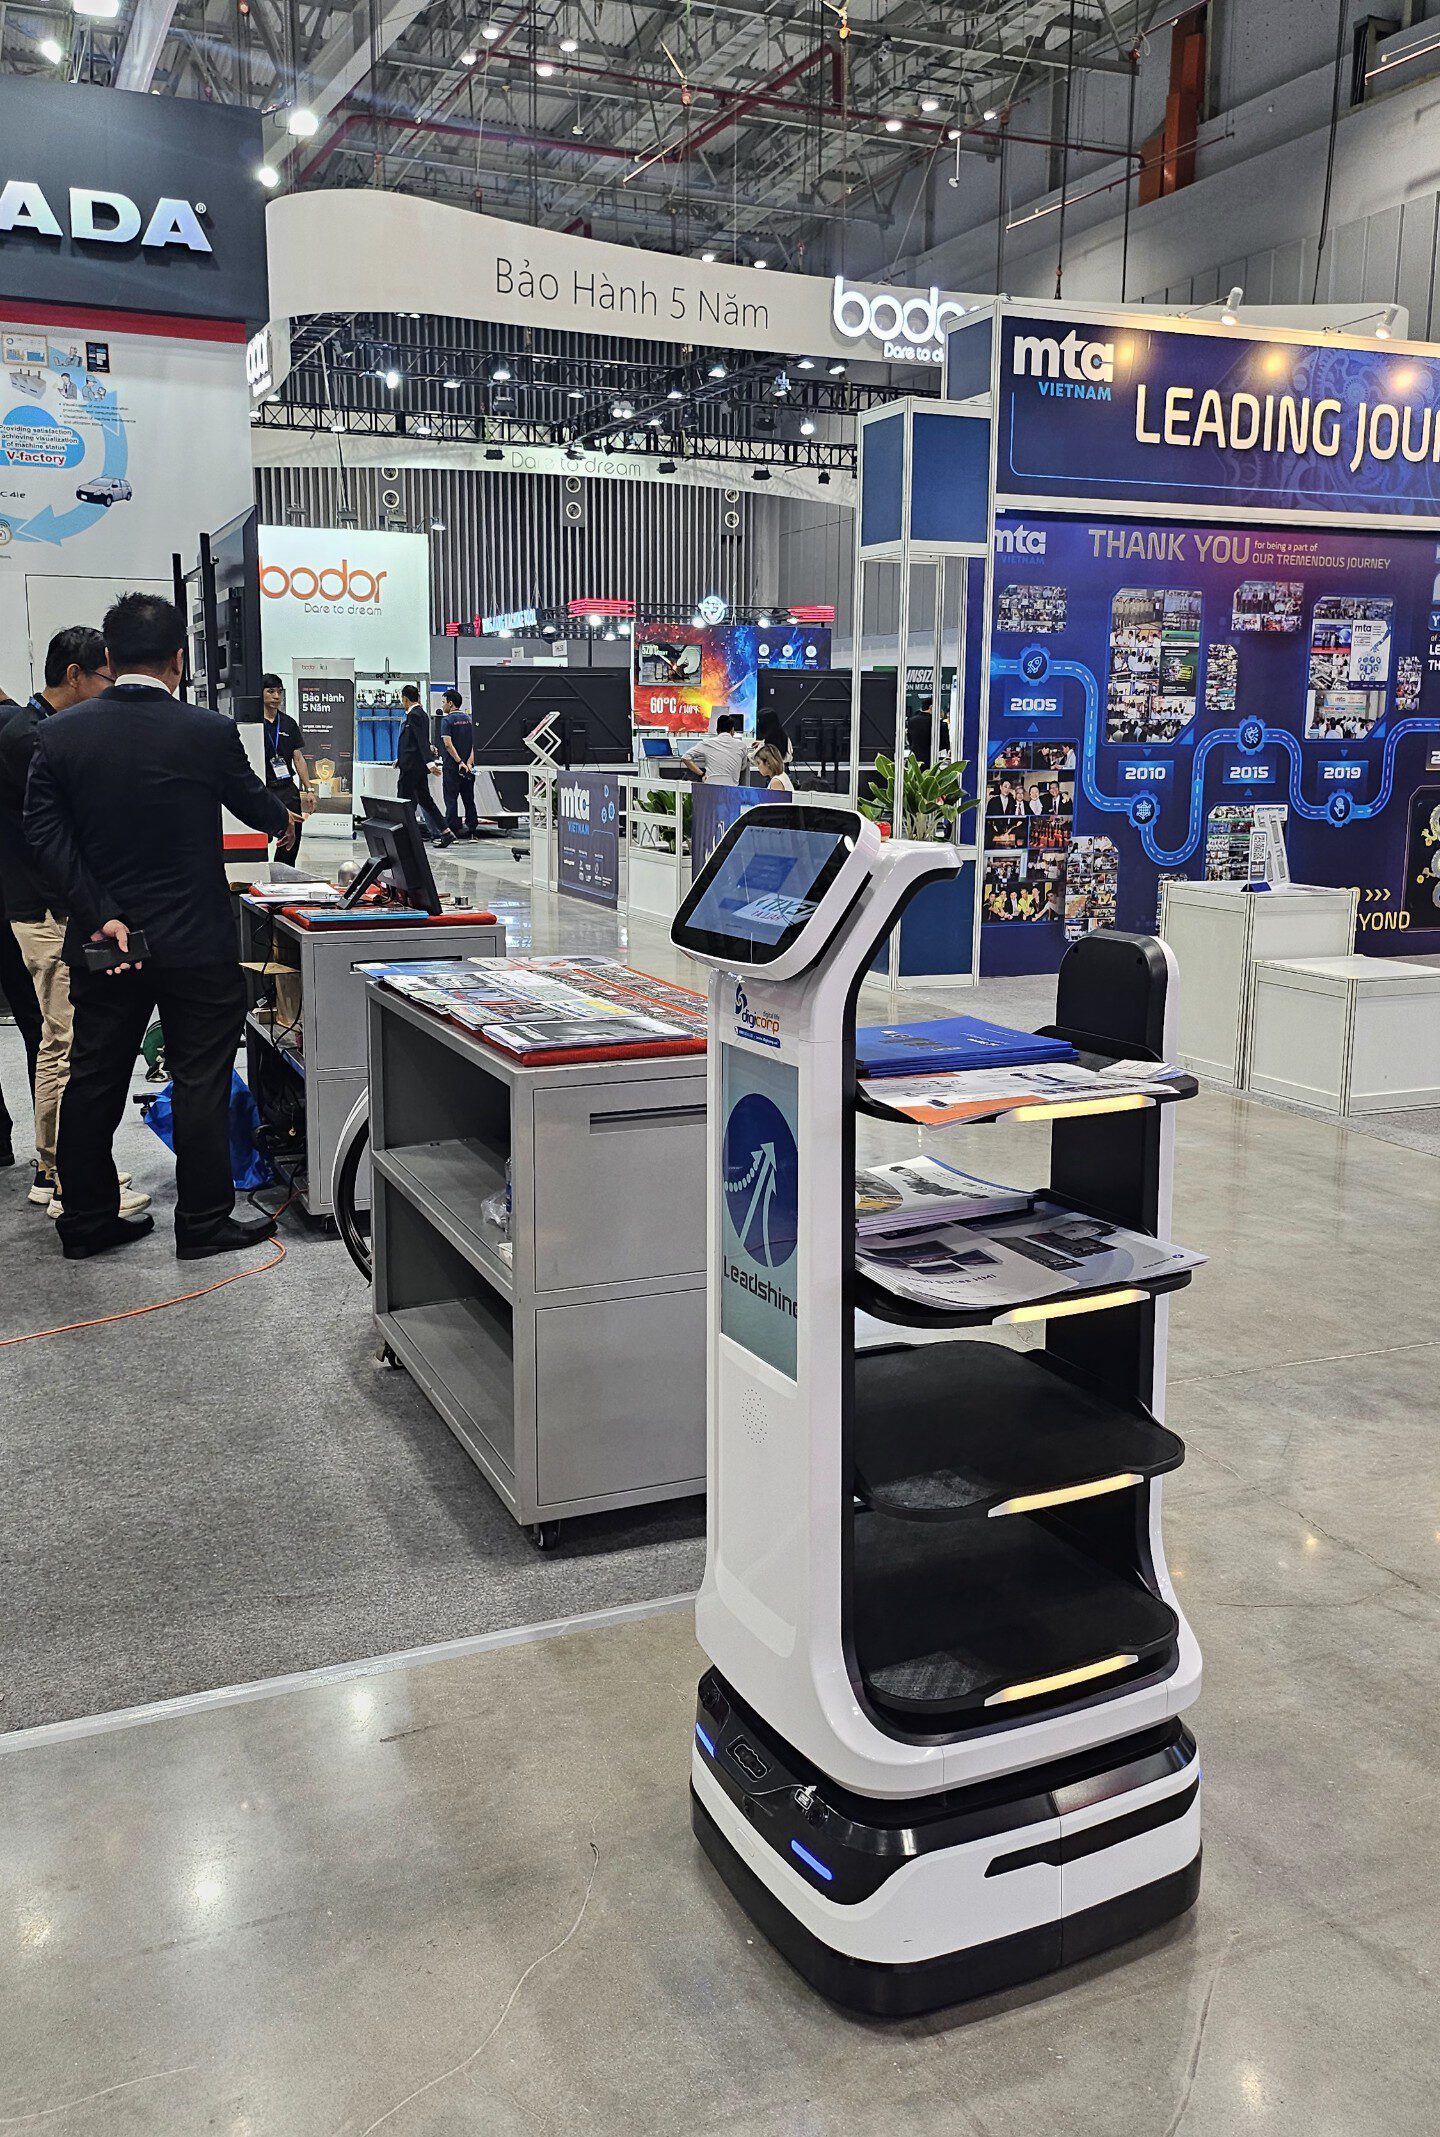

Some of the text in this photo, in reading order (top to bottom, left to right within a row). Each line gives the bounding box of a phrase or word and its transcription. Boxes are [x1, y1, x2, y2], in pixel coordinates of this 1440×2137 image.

[496, 257, 769, 329] Bảo Hành 5 Năm
[833, 275, 981, 345] bodo
[883, 341, 915, 360] Dare
[916, 347, 931, 361] to
[1013, 329, 1114, 383] mta
[1038, 381, 1112, 401] VIETNAM
[1135, 384, 1342, 456] LEADING
[0, 425, 72, 435] Providing satisfaction
[2, 434, 78, 444] achieving visualization
[15, 442, 44, 450] machine
[45, 443, 66, 451] status
[6, 450, 65, 466] V-factory
[560, 458, 579, 472] to
[584, 457, 641, 477] dream
[995, 524, 1046, 555] mta
[1088, 529, 1250, 565] THANK YOU
[1254, 540, 1266, 550] for
[1266, 541, 1287, 553] being
[1293, 543, 1309, 553] part
[1309, 543, 1319, 552] of
[1001, 554, 1045, 565] VIETNAM
[1252, 553, 1391, 571] OUR TREMENDOUS JOURNEY
[259, 555, 388, 604] bodor
[304, 602, 383, 616] Dare to dream
[1354, 624, 1372, 633] mta
[302, 691, 345, 703] Bảo Hành
[1010, 697, 1057, 712] 2005
[302, 702, 332, 713] 5 Năm
[650, 697, 677, 714] 60°C
[1125, 767, 1166, 780] 2010
[1229, 766, 1270, 780] 2015
[1323, 767, 1362, 780] 2019
[560, 781, 590, 821] mta
[568, 821, 590, 836] VIETNAM
[741, 1009, 780, 1035] digicorp
